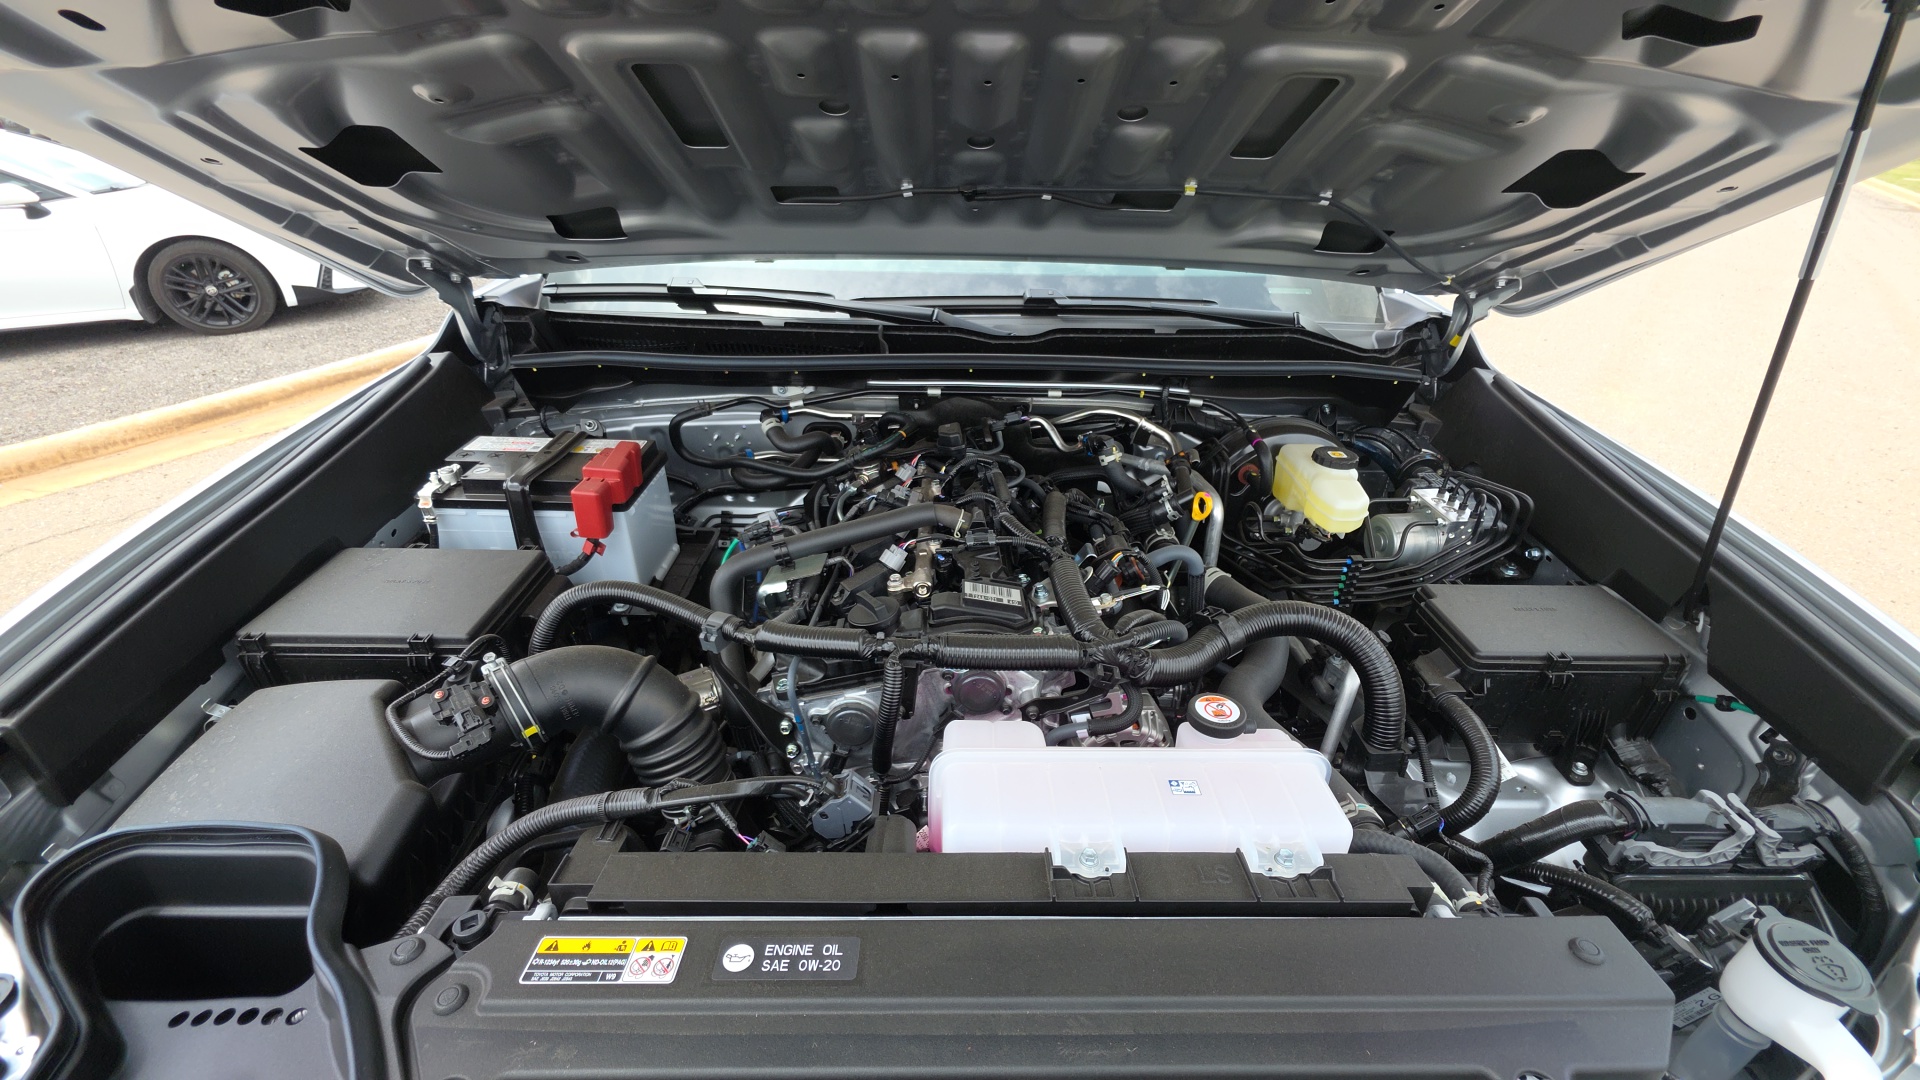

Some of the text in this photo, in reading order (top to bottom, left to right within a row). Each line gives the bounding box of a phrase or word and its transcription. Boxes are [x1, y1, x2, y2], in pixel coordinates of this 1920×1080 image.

[764, 944, 843, 956] ENGINE OIL
[761, 959, 841, 972] SAE 0W-20
